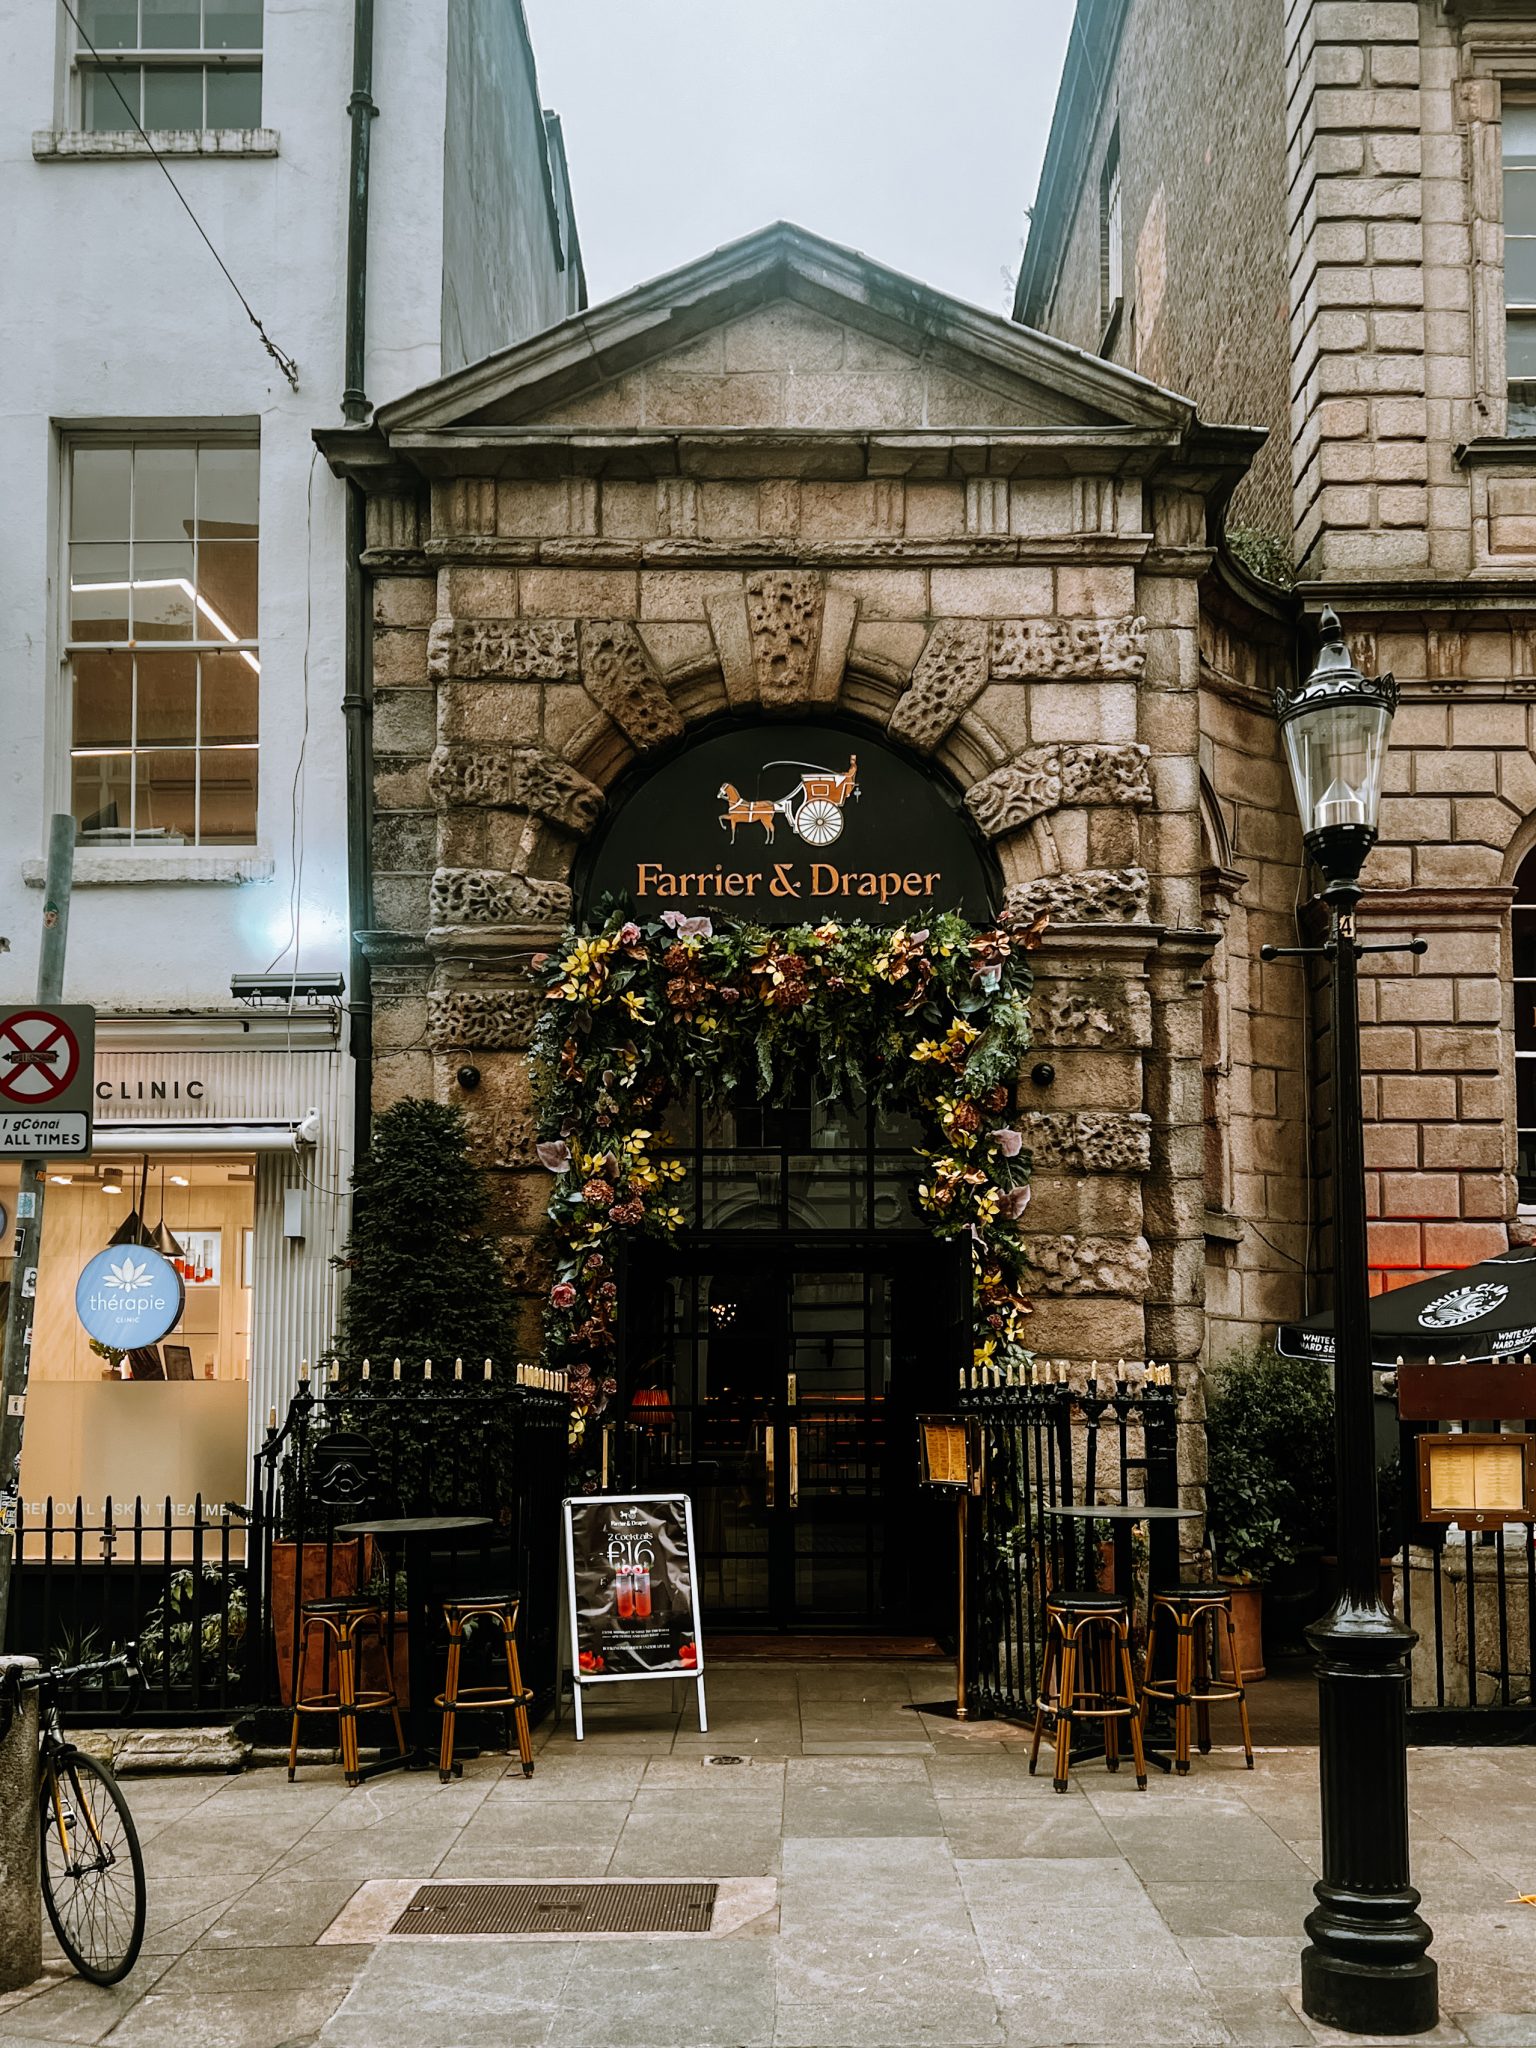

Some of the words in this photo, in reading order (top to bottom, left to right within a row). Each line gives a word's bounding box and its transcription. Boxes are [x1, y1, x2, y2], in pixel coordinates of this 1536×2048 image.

[636, 862, 762, 897] Farrier
[769, 863, 801, 898] &
[810, 863, 941, 905] Draper
[1341, 917, 1352, 935] 4
[96, 1080, 205, 1100] CLINIC
[4, 1134, 30, 1145] ALL
[34, 1133, 80, 1145] TIMES
[89, 1291, 166, 1315] thérapie
[1421, 1286, 1471, 1314] WHITE
[115, 1316, 140, 1324] CLINIC
[1302, 1333, 1330, 1345] WHITE
[1498, 1330, 1522, 1341] WHITE
[1492, 1339, 1514, 1349] HARD
[607, 1533, 614, 1541] 2
[614, 1532, 653, 1541] Cocktails
